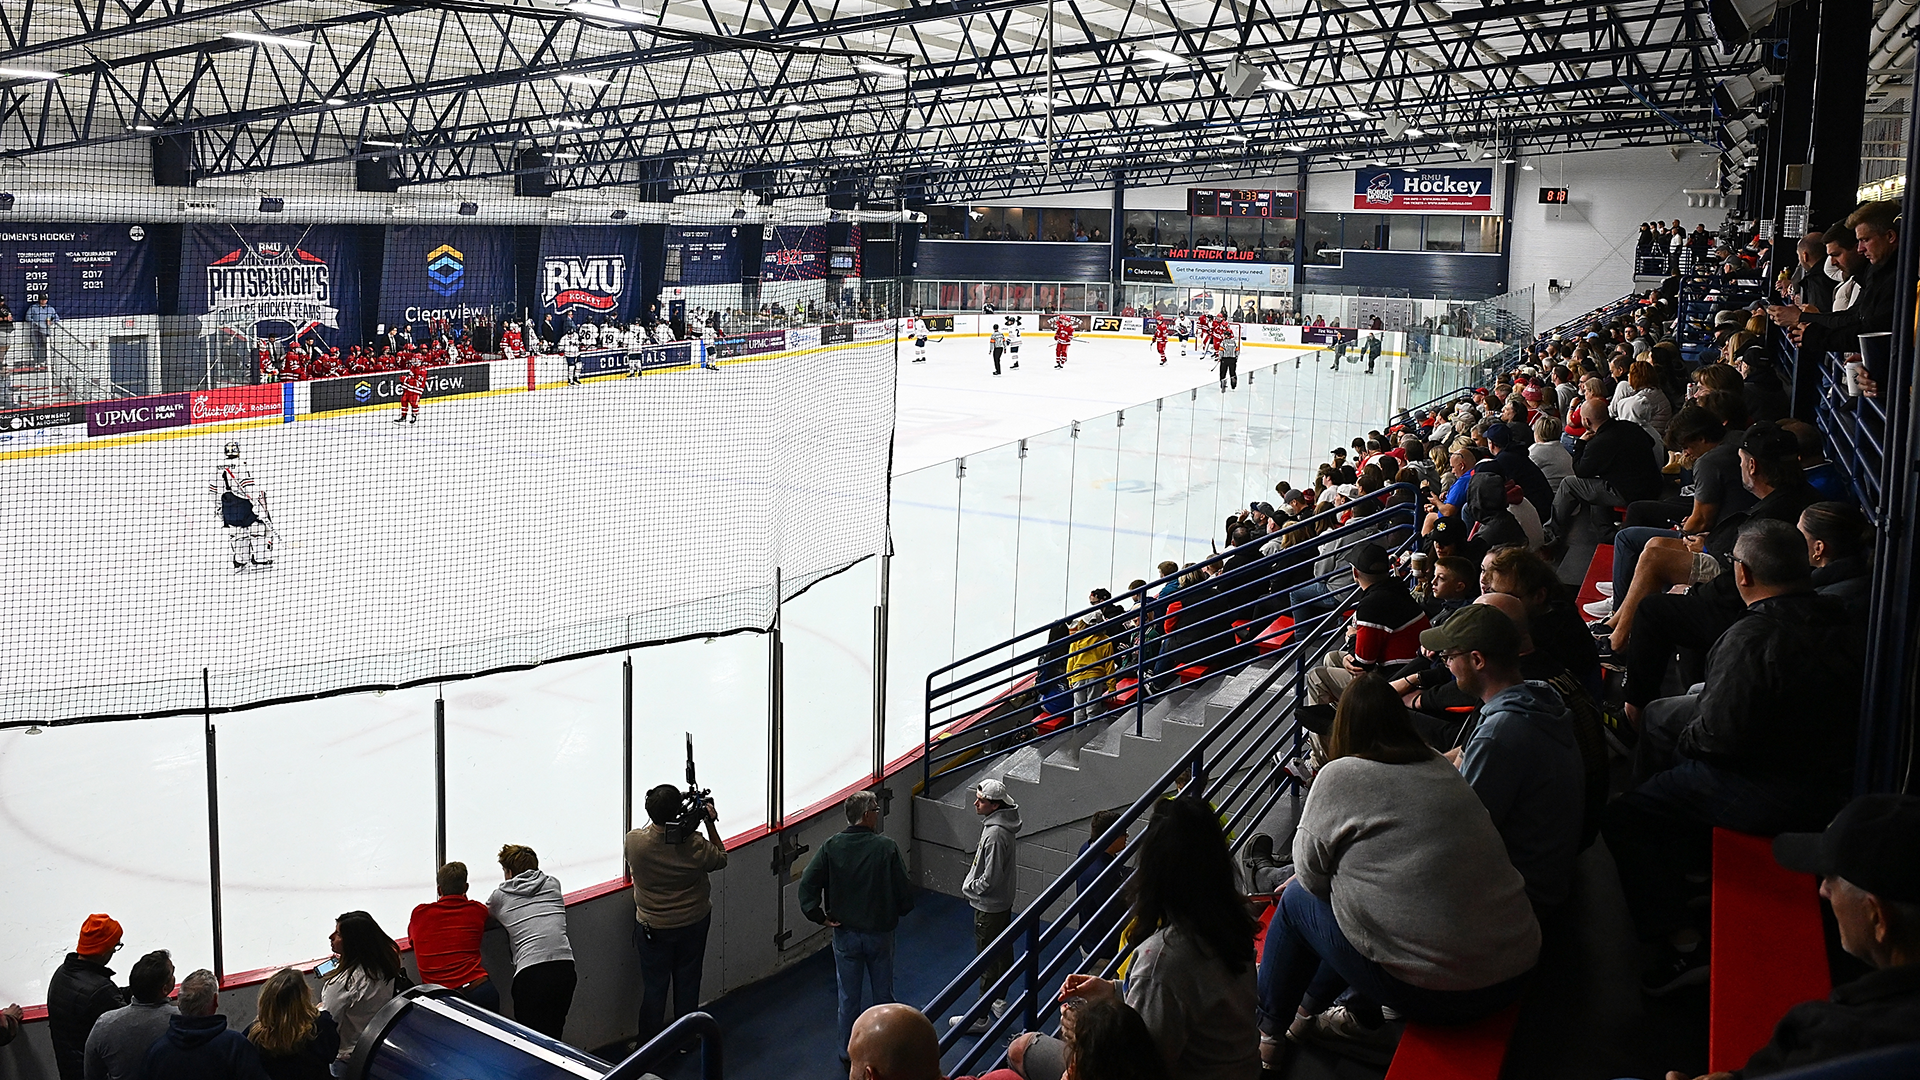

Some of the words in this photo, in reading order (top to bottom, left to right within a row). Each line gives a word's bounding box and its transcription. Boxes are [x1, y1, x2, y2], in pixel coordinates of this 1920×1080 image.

[1403, 175, 1482, 197] Hockey
[1238, 191, 1257, 200] 7:33
[1261, 206, 1268, 216] 0
[0, 233, 38, 241] OMEN'S
[39, 232, 76, 241] HOCKEY
[258, 242, 281, 252] RMU
[776, 249, 803, 265] 1921
[1169, 248, 1189, 258] HAT
[1192, 249, 1224, 259] TRICK
[1226, 251, 1255, 260] CLUB
[25, 272, 48, 280] 2012
[82, 270, 103, 278] 2017
[82, 281, 104, 289] 2021
[544, 259, 623, 302] RMU
[26, 282, 48, 291] 2017
[208, 266, 328, 306] PITTSBURGH'S
[569, 292, 601, 306] HOCKEY
[218, 303, 256, 325] COLLEGE
[257, 301, 292, 319] HOCKEY
[293, 302, 321, 320] TEAMS
[605, 333, 614, 344] 19
[748, 337, 770, 349] UPMC
[600, 351, 667, 369] COLOIALS
[377, 375, 465, 397] Cleview.
[154, 403, 184, 413] HEALTH
[250, 402, 282, 412] Robinson
[35, 411, 71, 420] TOWNSHIP
[95, 407, 150, 427] UPMC
[155, 412, 176, 420] PLAN
